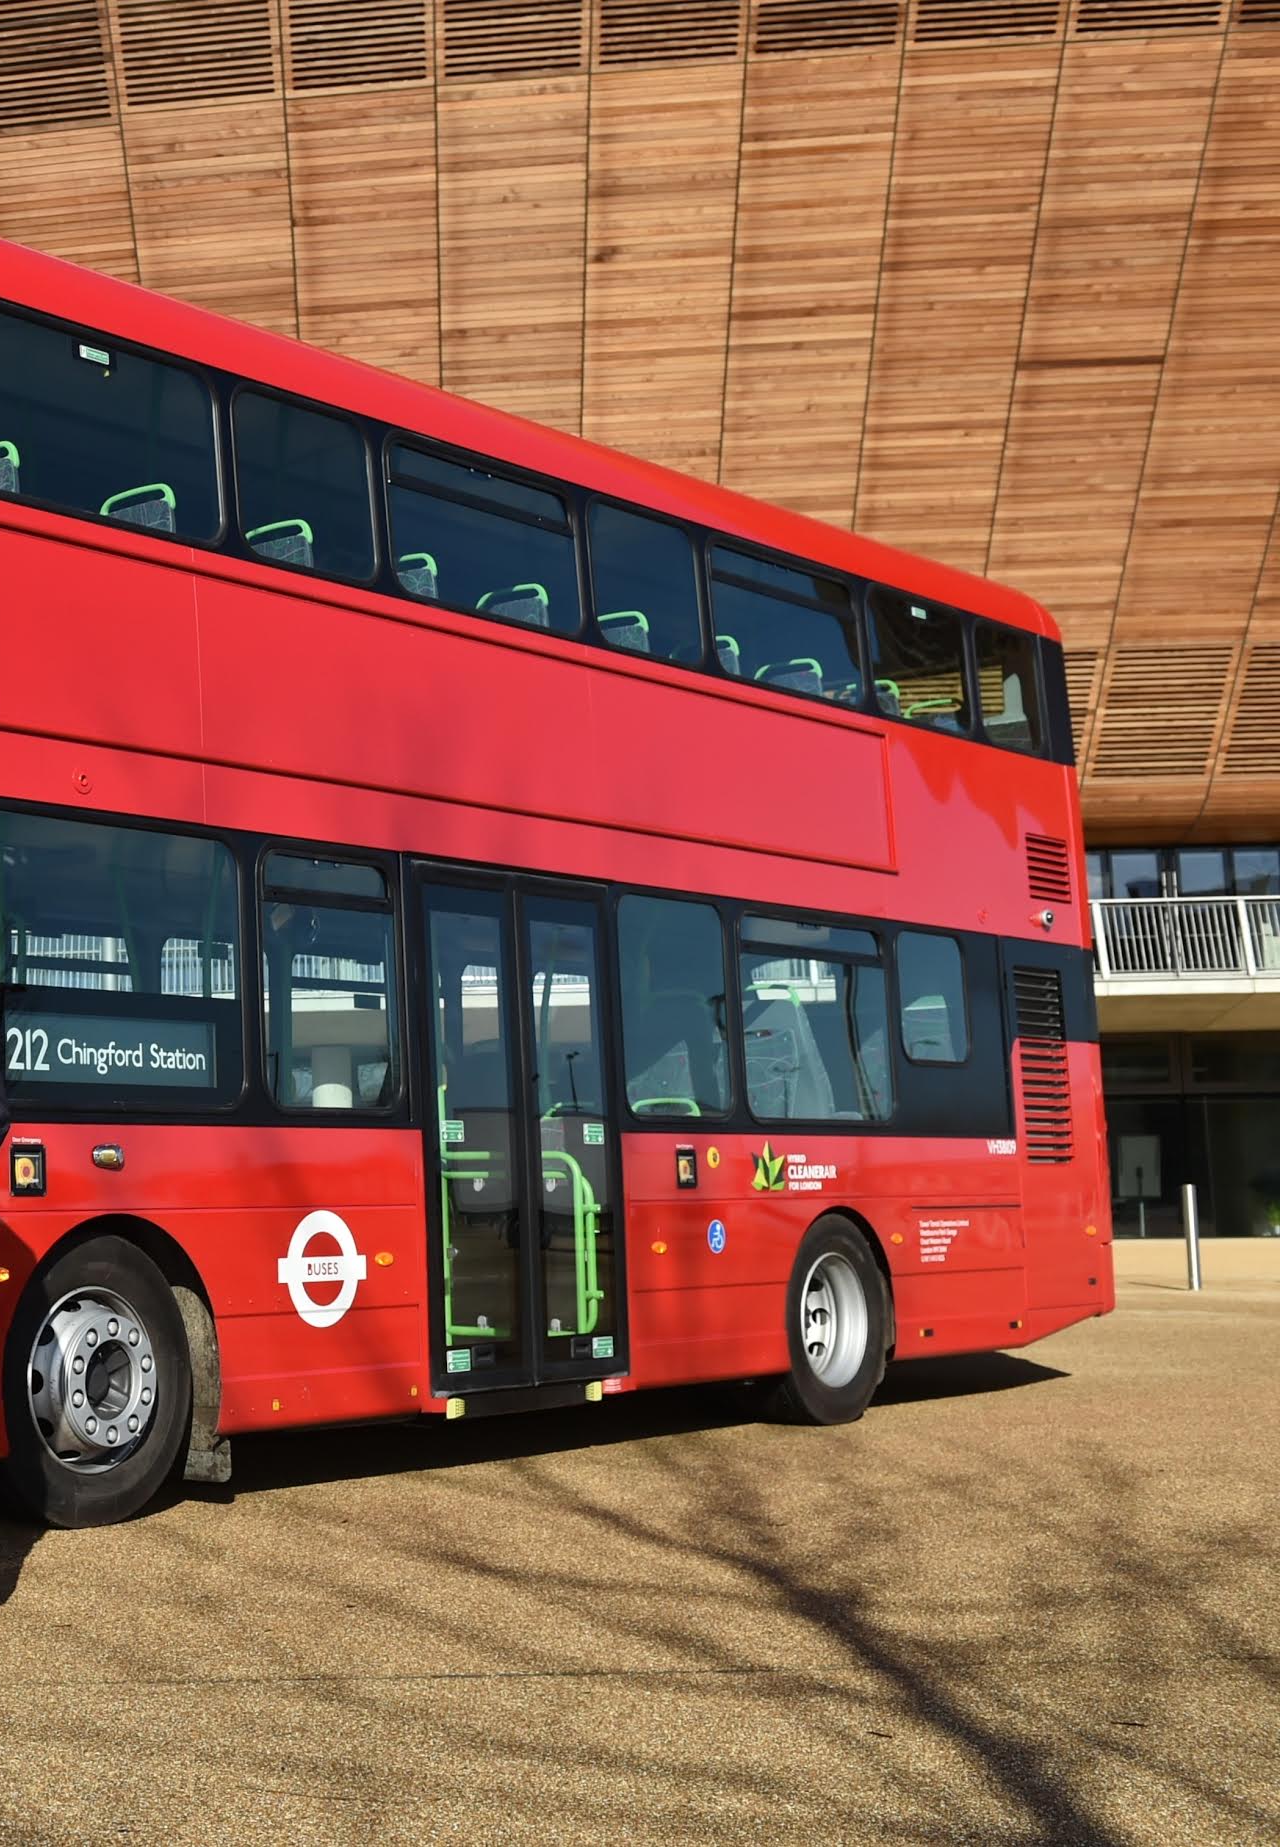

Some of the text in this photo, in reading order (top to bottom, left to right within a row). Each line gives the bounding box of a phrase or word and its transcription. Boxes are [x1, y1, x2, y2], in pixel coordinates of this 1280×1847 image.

[6, 1026, 206, 1075] 212 Chingford Station
[307, 1262, 339, 1276] BUSES
